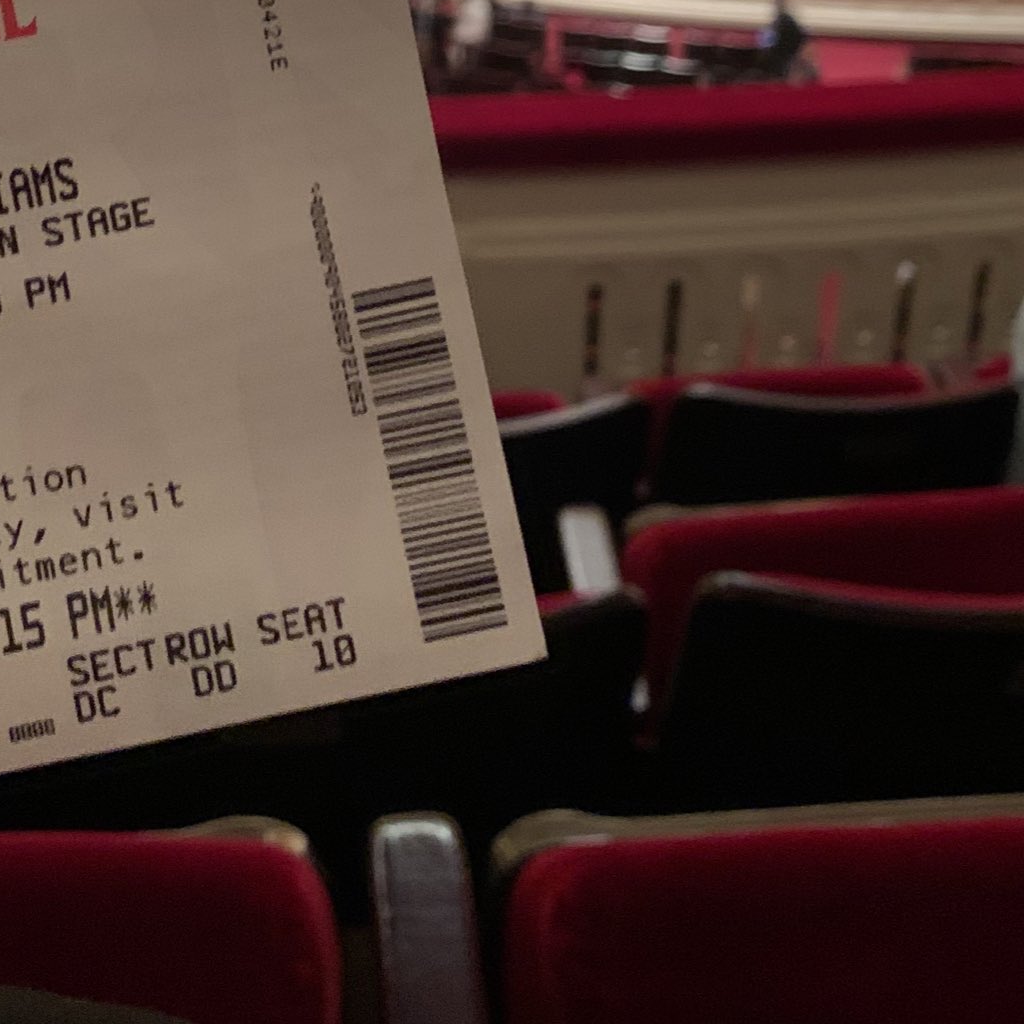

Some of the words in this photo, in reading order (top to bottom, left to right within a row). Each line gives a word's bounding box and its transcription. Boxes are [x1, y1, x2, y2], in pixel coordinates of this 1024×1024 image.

[41, 196, 155, 247] STAGE
[24, 271, 71, 310] PM
[72, 481, 184, 528] visit
[66, 638, 156, 687] SECT
[164, 622, 236, 666] ROW
[256, 597, 345, 646] SEAT
[72, 684, 121, 724] DC
[190, 659, 238, 698] DD
[311, 634, 357, 672] 10
